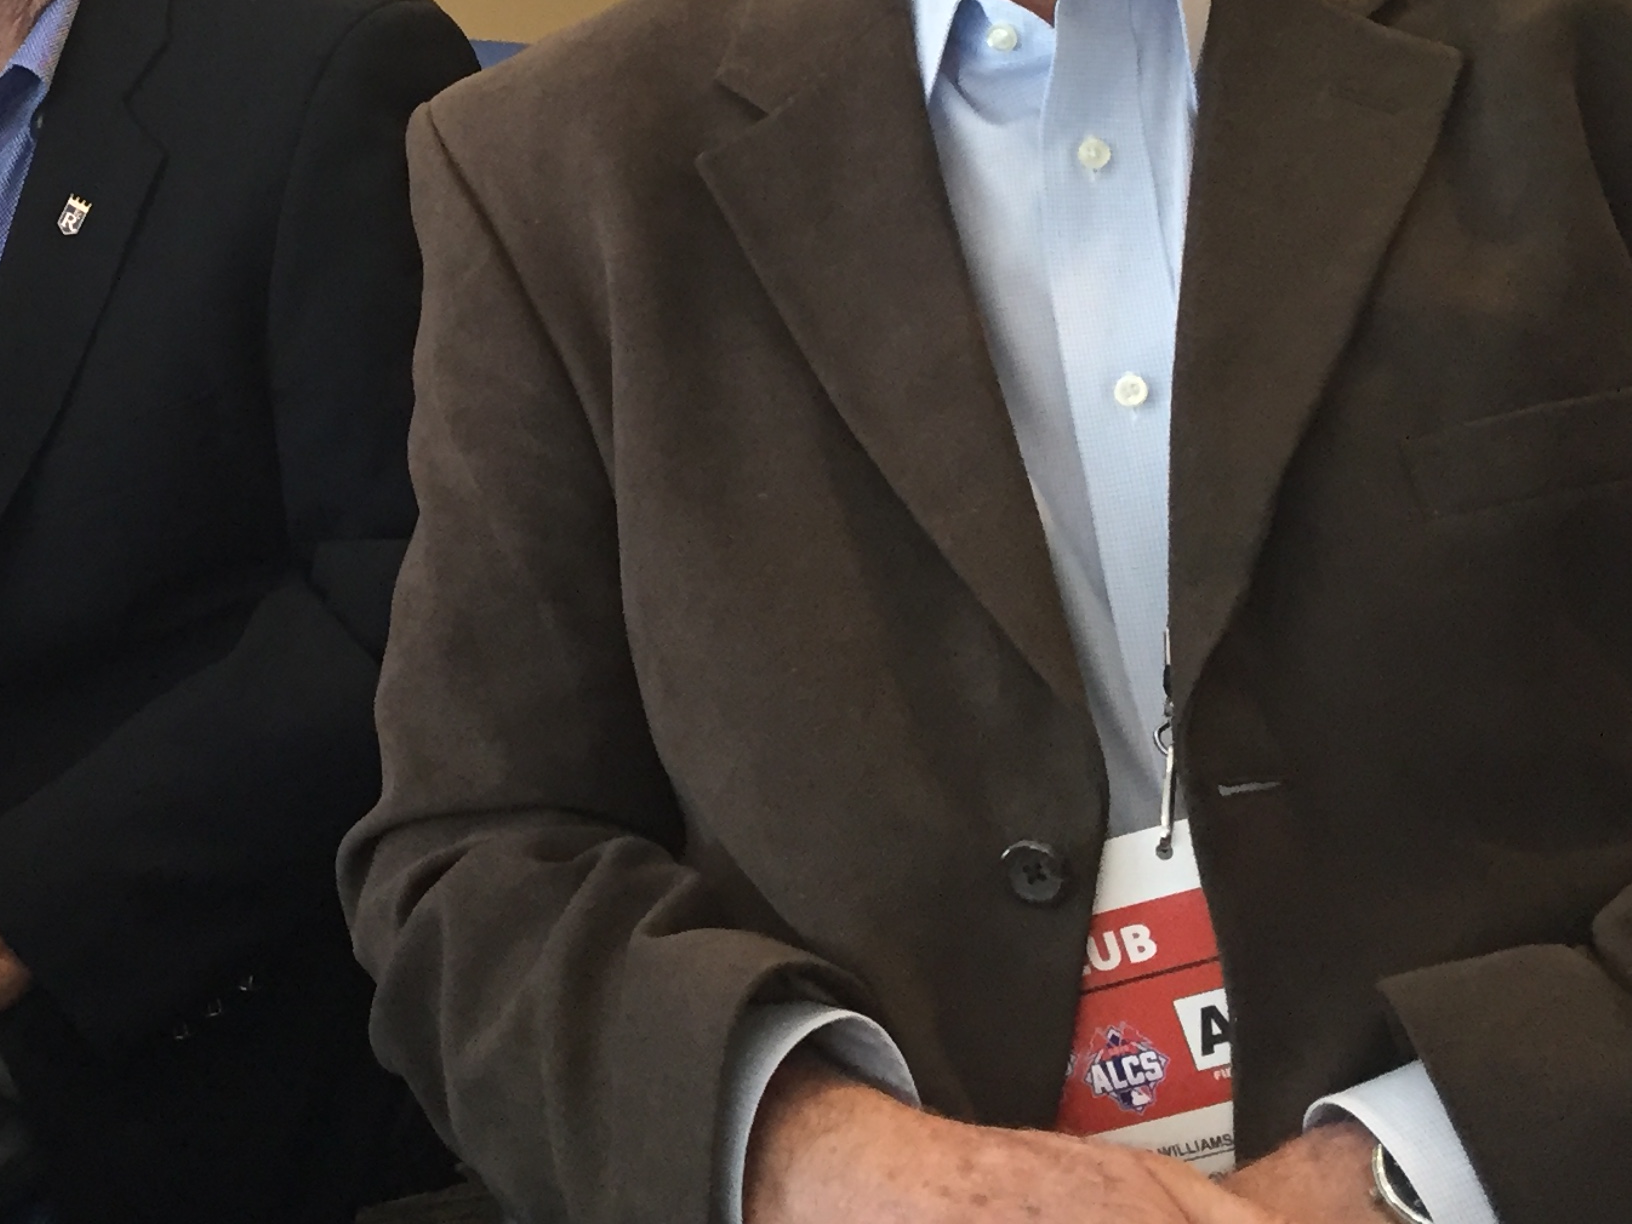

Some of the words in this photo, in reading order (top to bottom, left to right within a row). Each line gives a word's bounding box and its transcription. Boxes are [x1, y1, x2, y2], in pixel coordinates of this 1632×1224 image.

[61, 211, 78, 233] R
[1082, 923, 1159, 976] UB
[1200, 1005, 1233, 1057] A
[1090, 1051, 1164, 1095] ALCS
[1156, 1133, 1234, 1158] WILLIAMS
